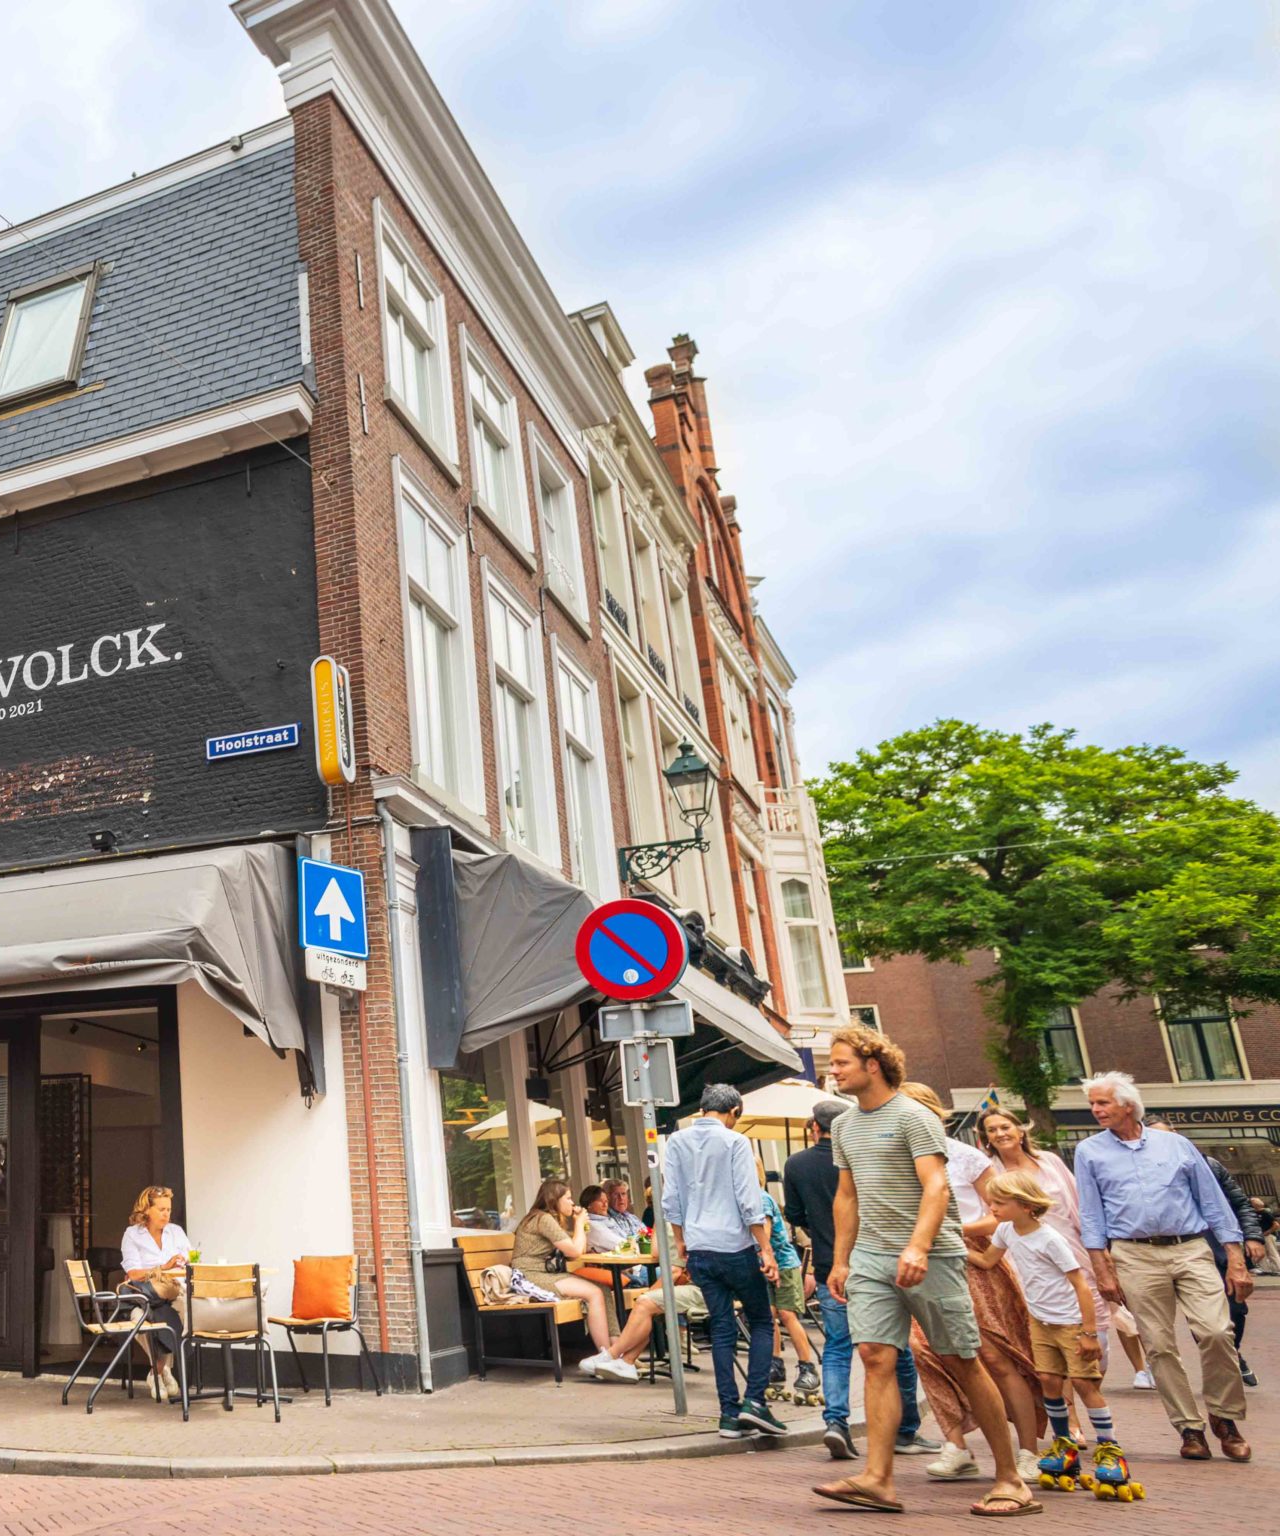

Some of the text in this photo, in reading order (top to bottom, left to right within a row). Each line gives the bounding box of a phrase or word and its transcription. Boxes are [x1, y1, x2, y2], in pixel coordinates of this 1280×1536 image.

[9, 699, 43, 718] 2021
[215, 729, 289, 752] Hooistraat
[316, 952, 359, 968] uitgezonderd
[1191, 1110, 1239, 1122] CAMP
[1243, 1110, 1255, 1120] &
